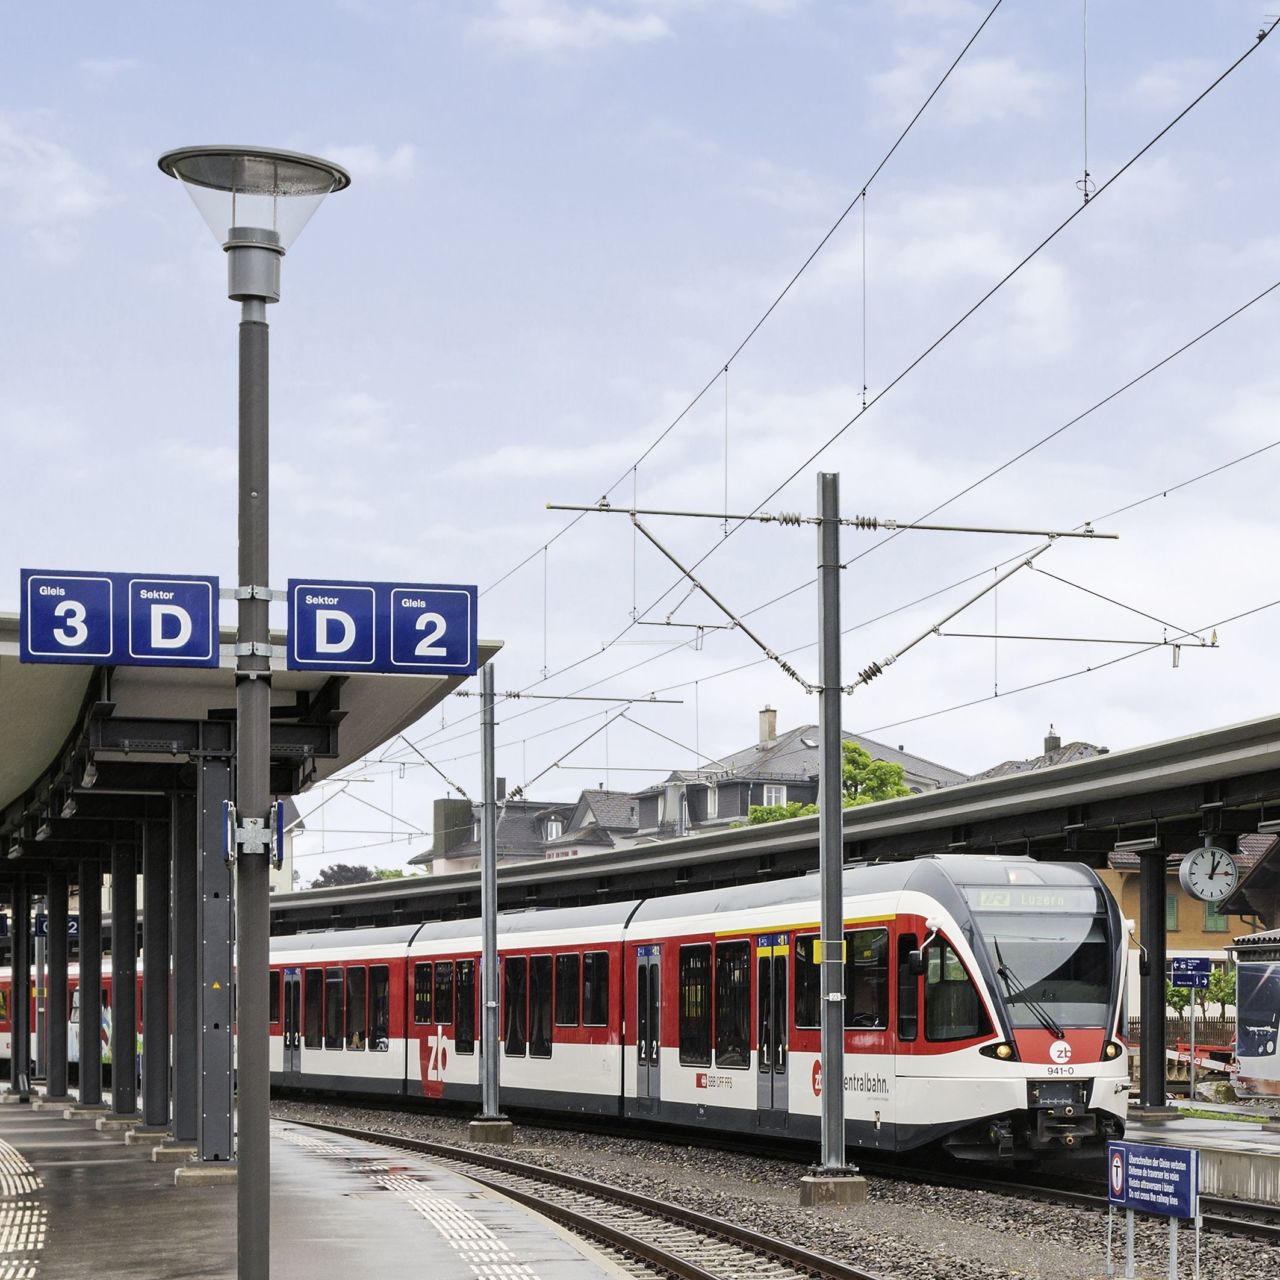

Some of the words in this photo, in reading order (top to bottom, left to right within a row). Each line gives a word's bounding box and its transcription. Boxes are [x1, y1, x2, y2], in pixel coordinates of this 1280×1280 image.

[39, 586, 65, 596] Gleis
[139, 589, 174, 600] Sektor
[305, 595, 339, 605] Sektor
[401, 599, 426, 608] Gleis
[53, 600, 88, 646] 3
[151, 604, 192, 648] D
[316, 609, 356, 653] D
[414, 612, 447, 656] 2
[1021, 893, 1064, 905] Luzern
[68, 921, 78, 933] 2
[641, 1041, 646, 1058] 2
[652, 1041, 657, 1058] 2
[763, 1044, 767, 1064] 1
[778, 1044, 782, 1064] 1
[1057, 1047, 1072, 1058] zb
[1047, 1067, 1074, 1075] 941-0
[843, 1072, 889, 1093] entralbahn.
